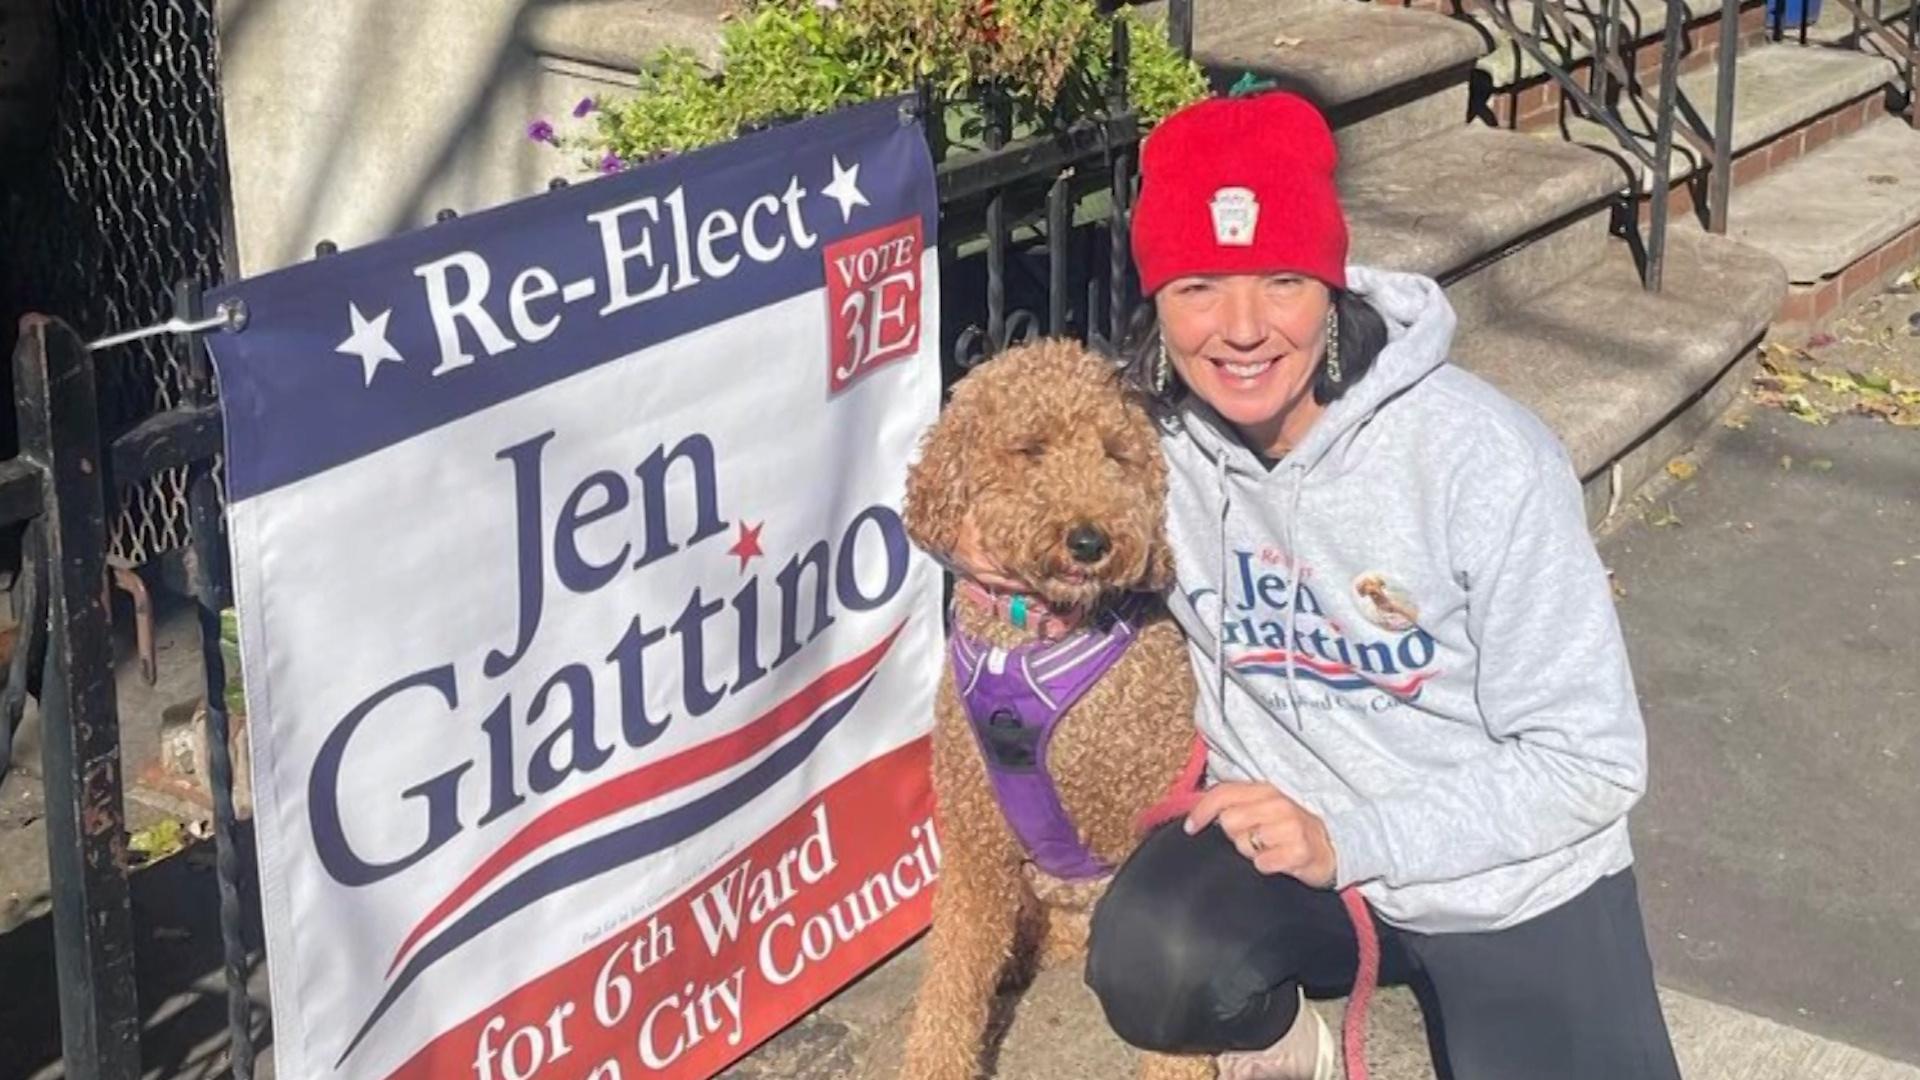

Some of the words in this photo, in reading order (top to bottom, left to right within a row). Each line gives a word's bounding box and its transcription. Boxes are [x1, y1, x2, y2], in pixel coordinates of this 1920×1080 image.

[414, 174, 820, 378] Re-Elect
[834, 234, 916, 288] VOTE
[836, 270, 917, 380] 3E
[483, 430, 730, 678] Jen
[1232, 550, 1325, 617] Jen
[308, 504, 911, 887] Giattino
[472, 1001, 576, 1080] for
[594, 916, 676, 1028] 6th
[689, 802, 840, 958] Ward
[637, 967, 747, 1071] City
[758, 816, 942, 986] Council
